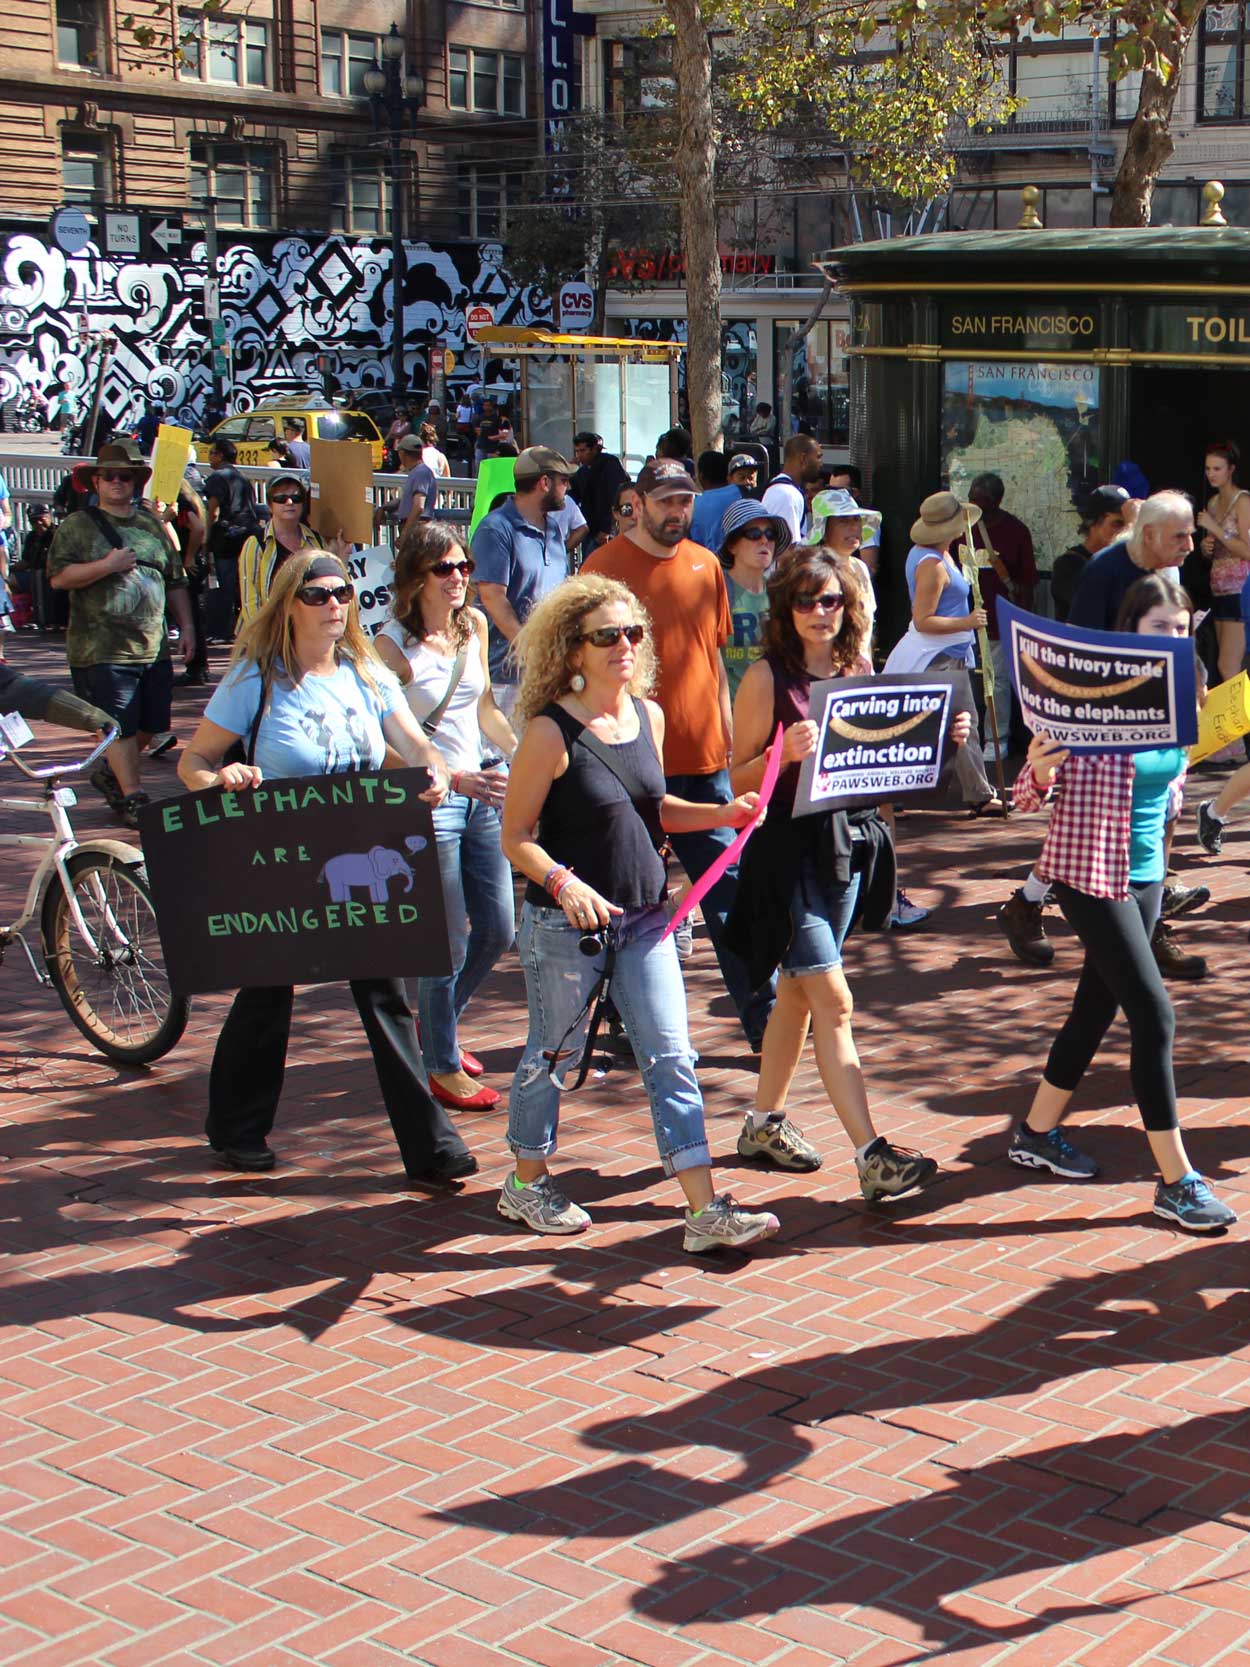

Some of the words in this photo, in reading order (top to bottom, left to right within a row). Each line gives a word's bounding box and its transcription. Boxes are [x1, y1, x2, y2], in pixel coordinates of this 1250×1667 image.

[117, 224, 129, 233] NO
[109, 234, 137, 243] TURNS
[561, 292, 593, 310] CVS
[479, 313, 490, 321] NOT
[561, 308, 592, 318] pharmacy
[951, 316, 986, 334] SAN
[991, 316, 1094, 335] FRANCISCO
[977, 366, 1006, 379] SAN
[1011, 367, 1094, 381] FRANCISCO
[1019, 636, 1039, 660] Kill
[1040, 646, 1066, 669] the
[1068, 652, 1112, 678] ivory
[1114, 660, 1163, 678] trade
[831, 695, 900, 718] Carving
[902, 694, 942, 713] into
[1021, 684, 1042, 711] Not
[1043, 698, 1071, 718] the
[1074, 703, 1166, 723] elephants
[823, 742, 933, 769] extinction
[832, 772, 934, 791] PAWSWEB.ORG
[162, 777, 406, 833] ELEPHANTS
[251, 845, 311, 865] ARE
[207, 901, 418, 936] ENDANGERED
